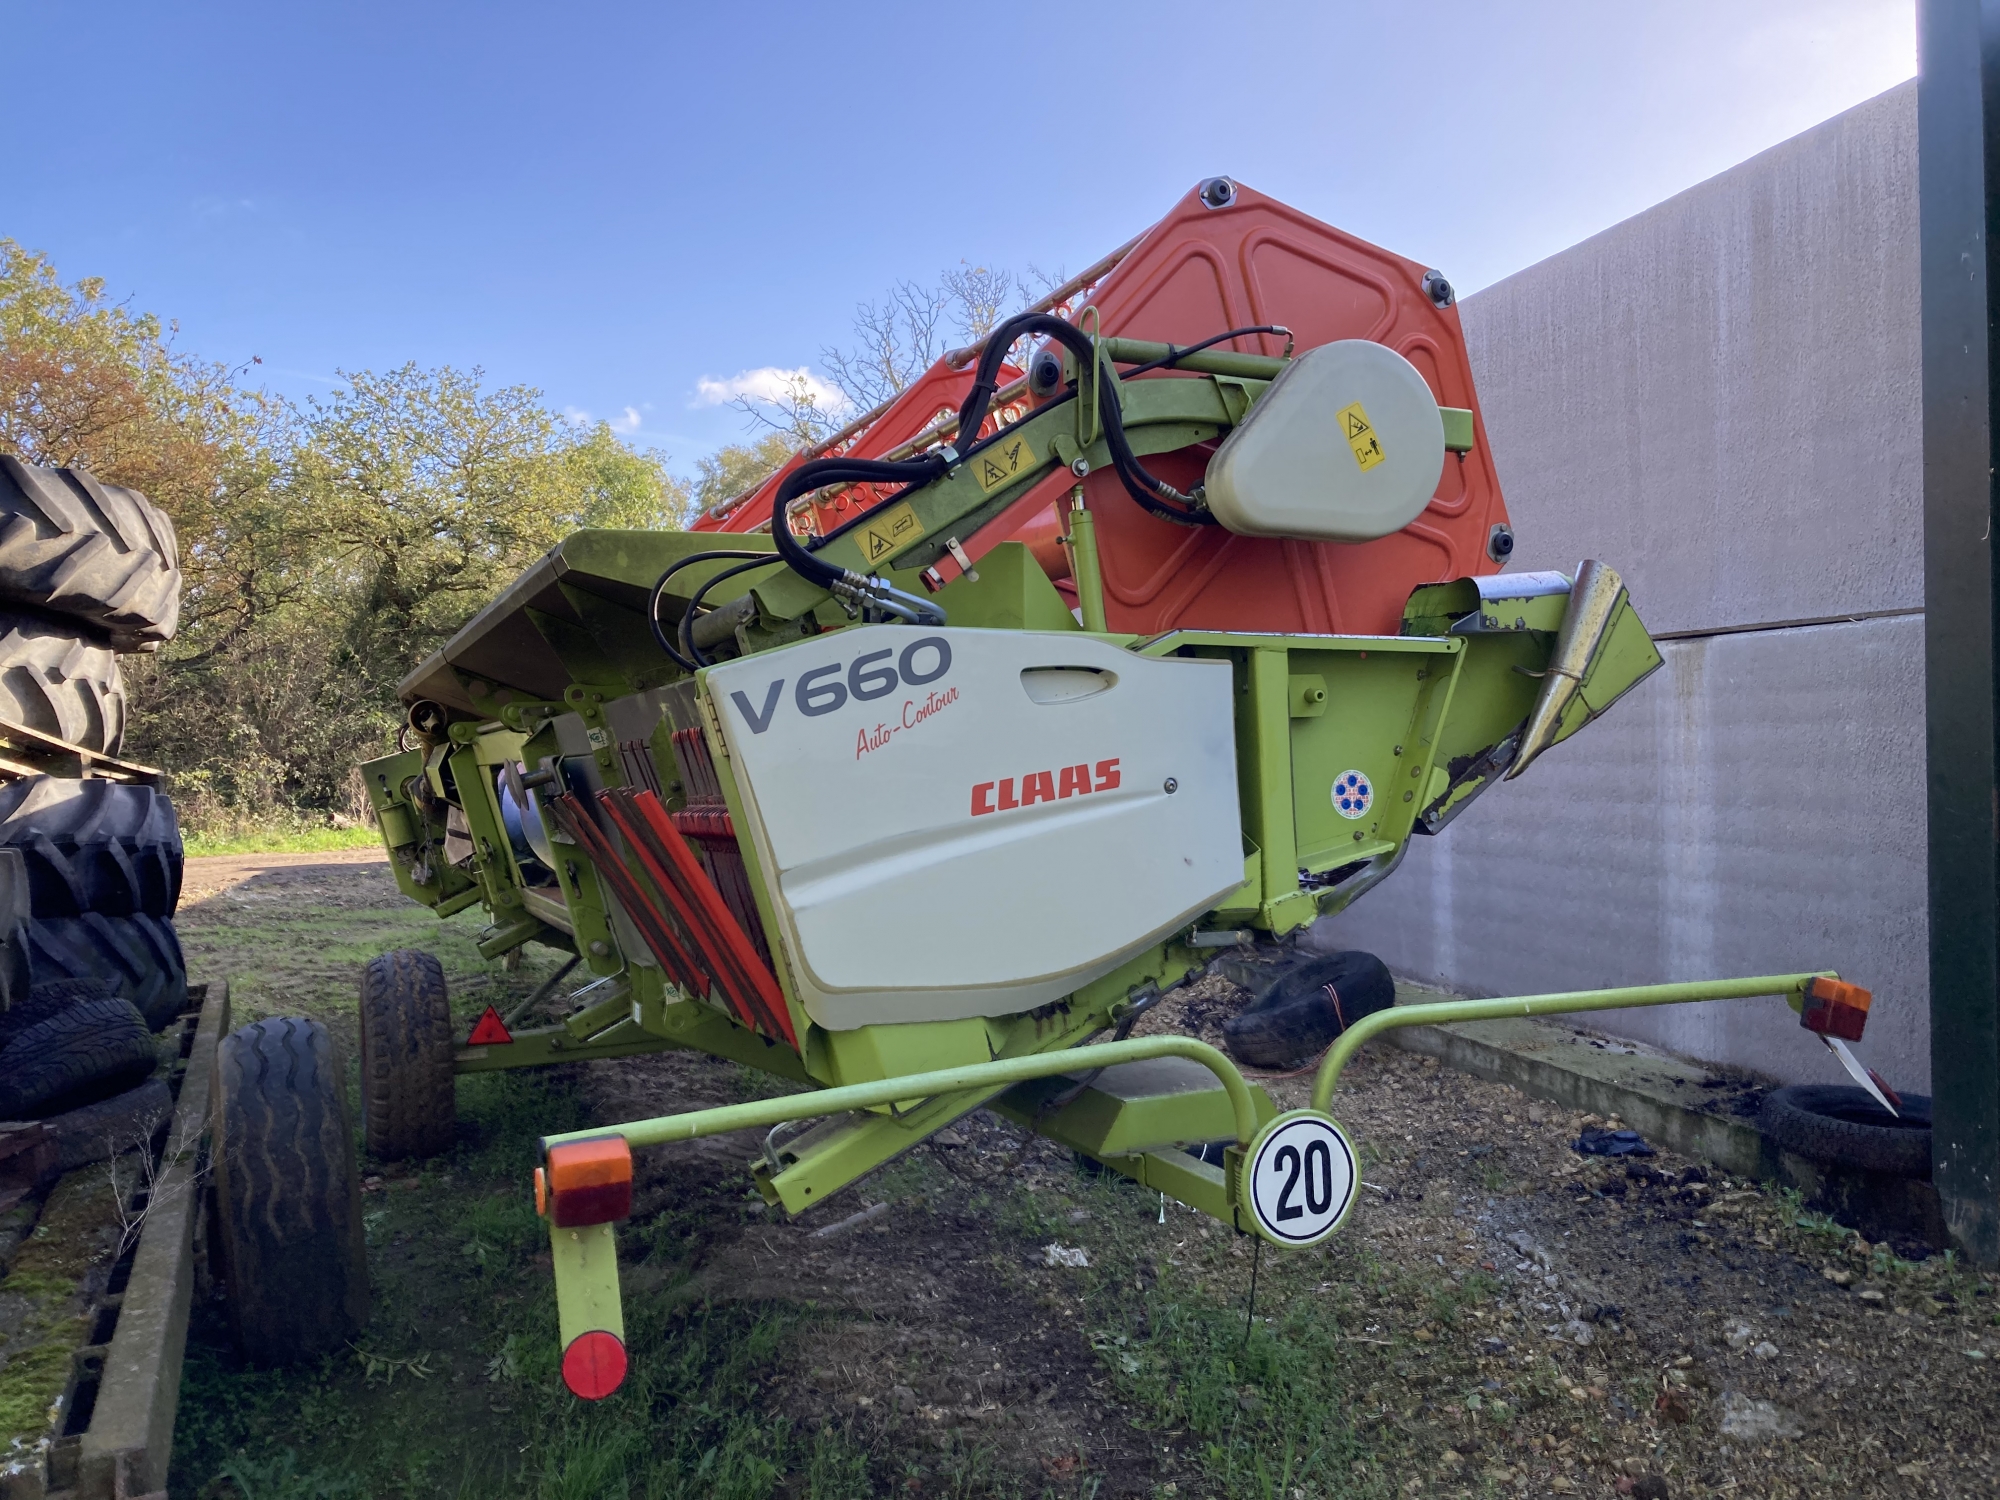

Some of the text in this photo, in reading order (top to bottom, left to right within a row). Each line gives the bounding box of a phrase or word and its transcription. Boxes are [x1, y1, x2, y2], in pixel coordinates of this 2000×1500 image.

[730, 636, 952, 735] V 660
[856, 686, 959, 760] Auto-Contour
[971, 758, 1121, 816] CLAAS
[1274, 1140, 1332, 1221] 20
